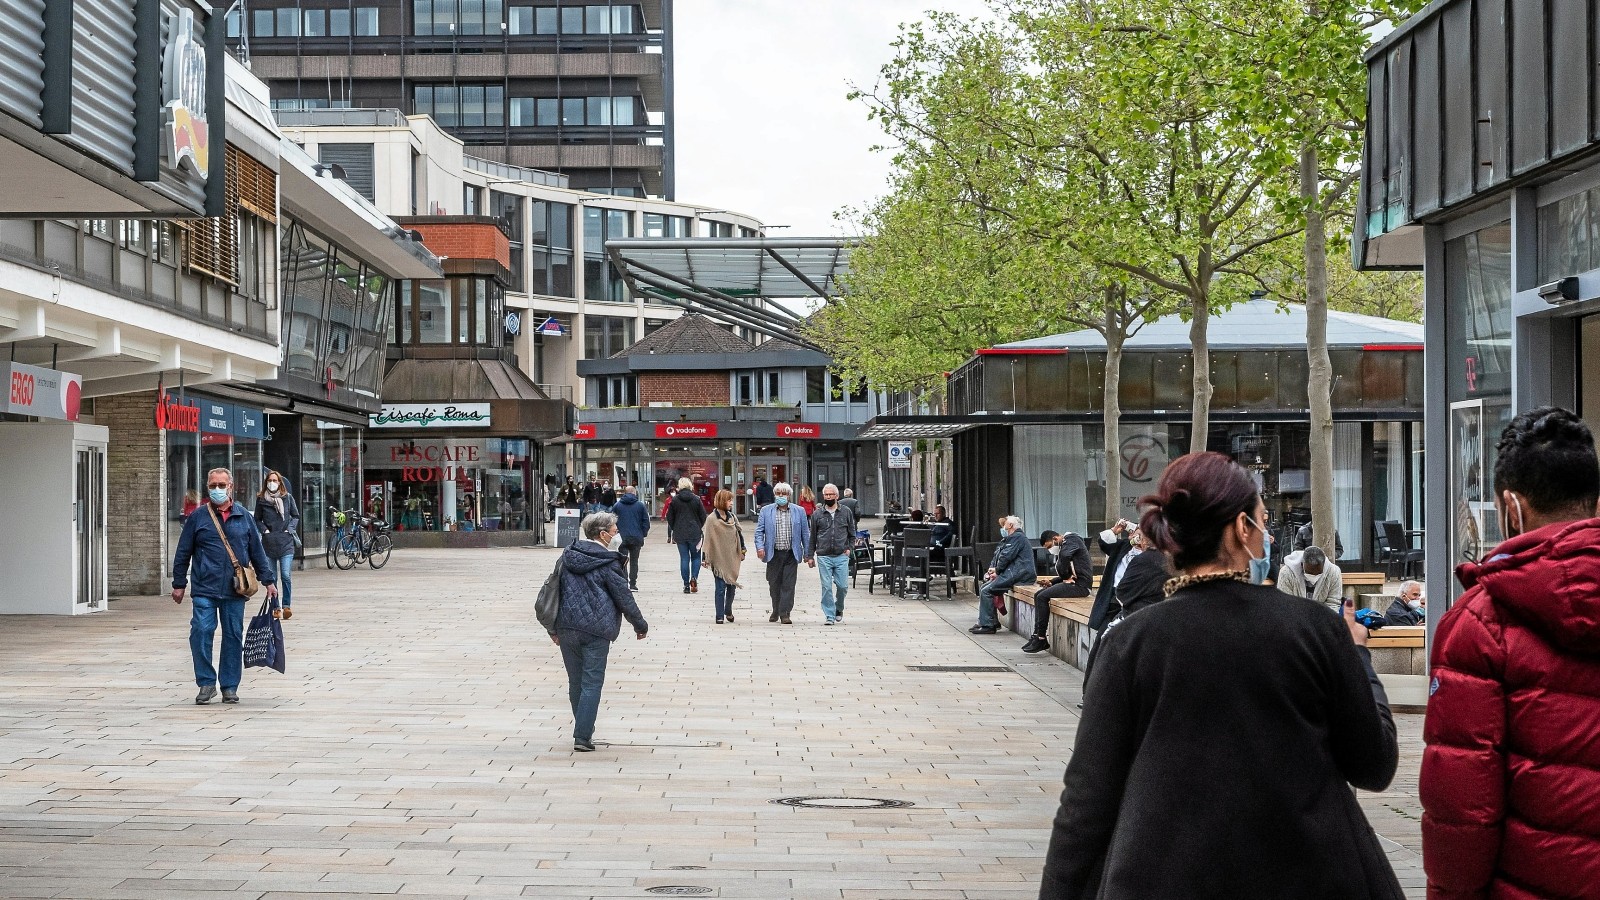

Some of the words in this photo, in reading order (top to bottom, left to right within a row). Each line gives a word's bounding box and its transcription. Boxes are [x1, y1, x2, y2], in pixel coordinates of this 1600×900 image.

[11, 371, 34, 406] ERGO
[165, 394, 200, 432] Santander
[443, 406, 481, 419] Roma
[676, 426, 707, 434] vodafone
[791, 426, 813, 434] vodafone
[390, 445, 480, 462] EISCAFE
[401, 464, 469, 482] ROMA
